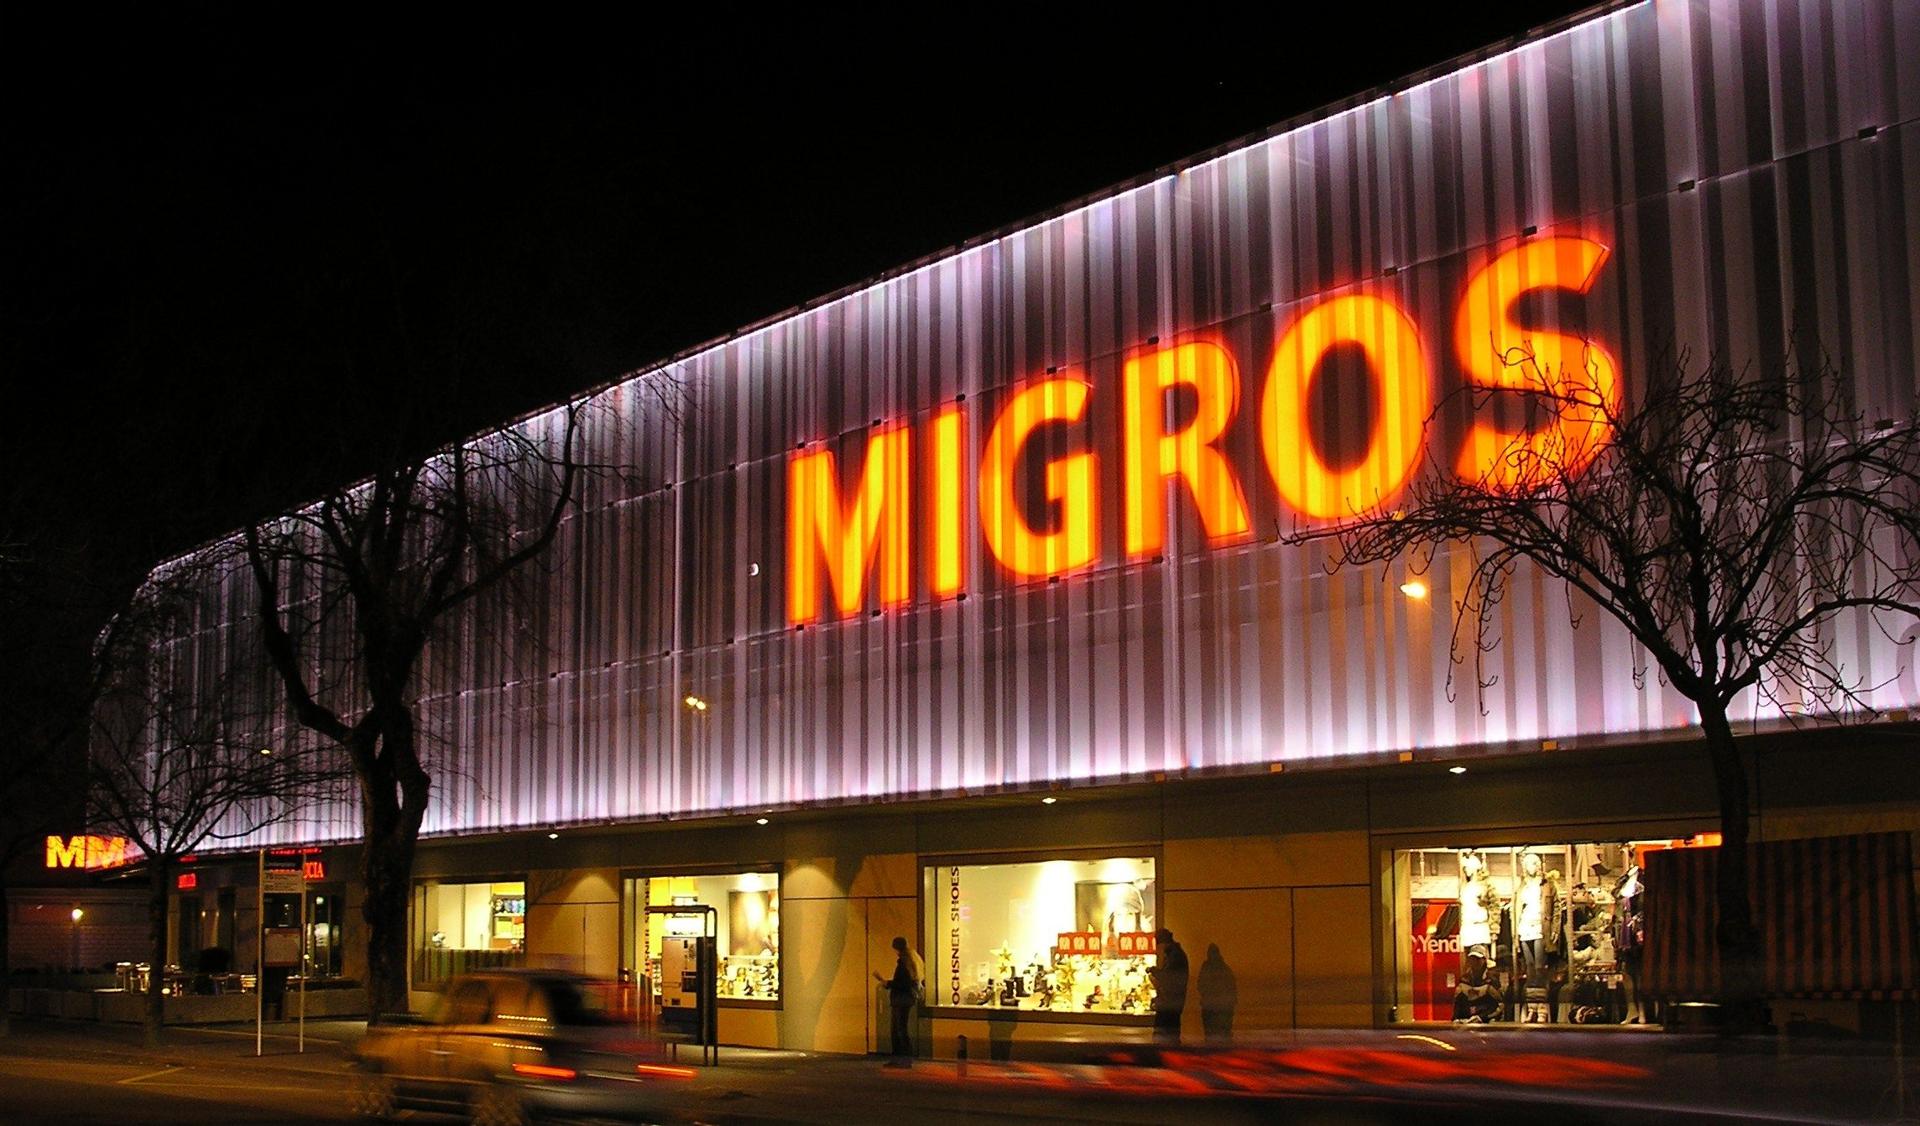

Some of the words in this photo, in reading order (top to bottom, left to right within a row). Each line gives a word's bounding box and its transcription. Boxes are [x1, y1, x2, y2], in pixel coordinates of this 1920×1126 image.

[787, 237, 1620, 628] MIGROS
[46, 835, 125, 869] MM
[951, 865, 960, 922] SHOES
[951, 927, 960, 1006] OCHSNER
